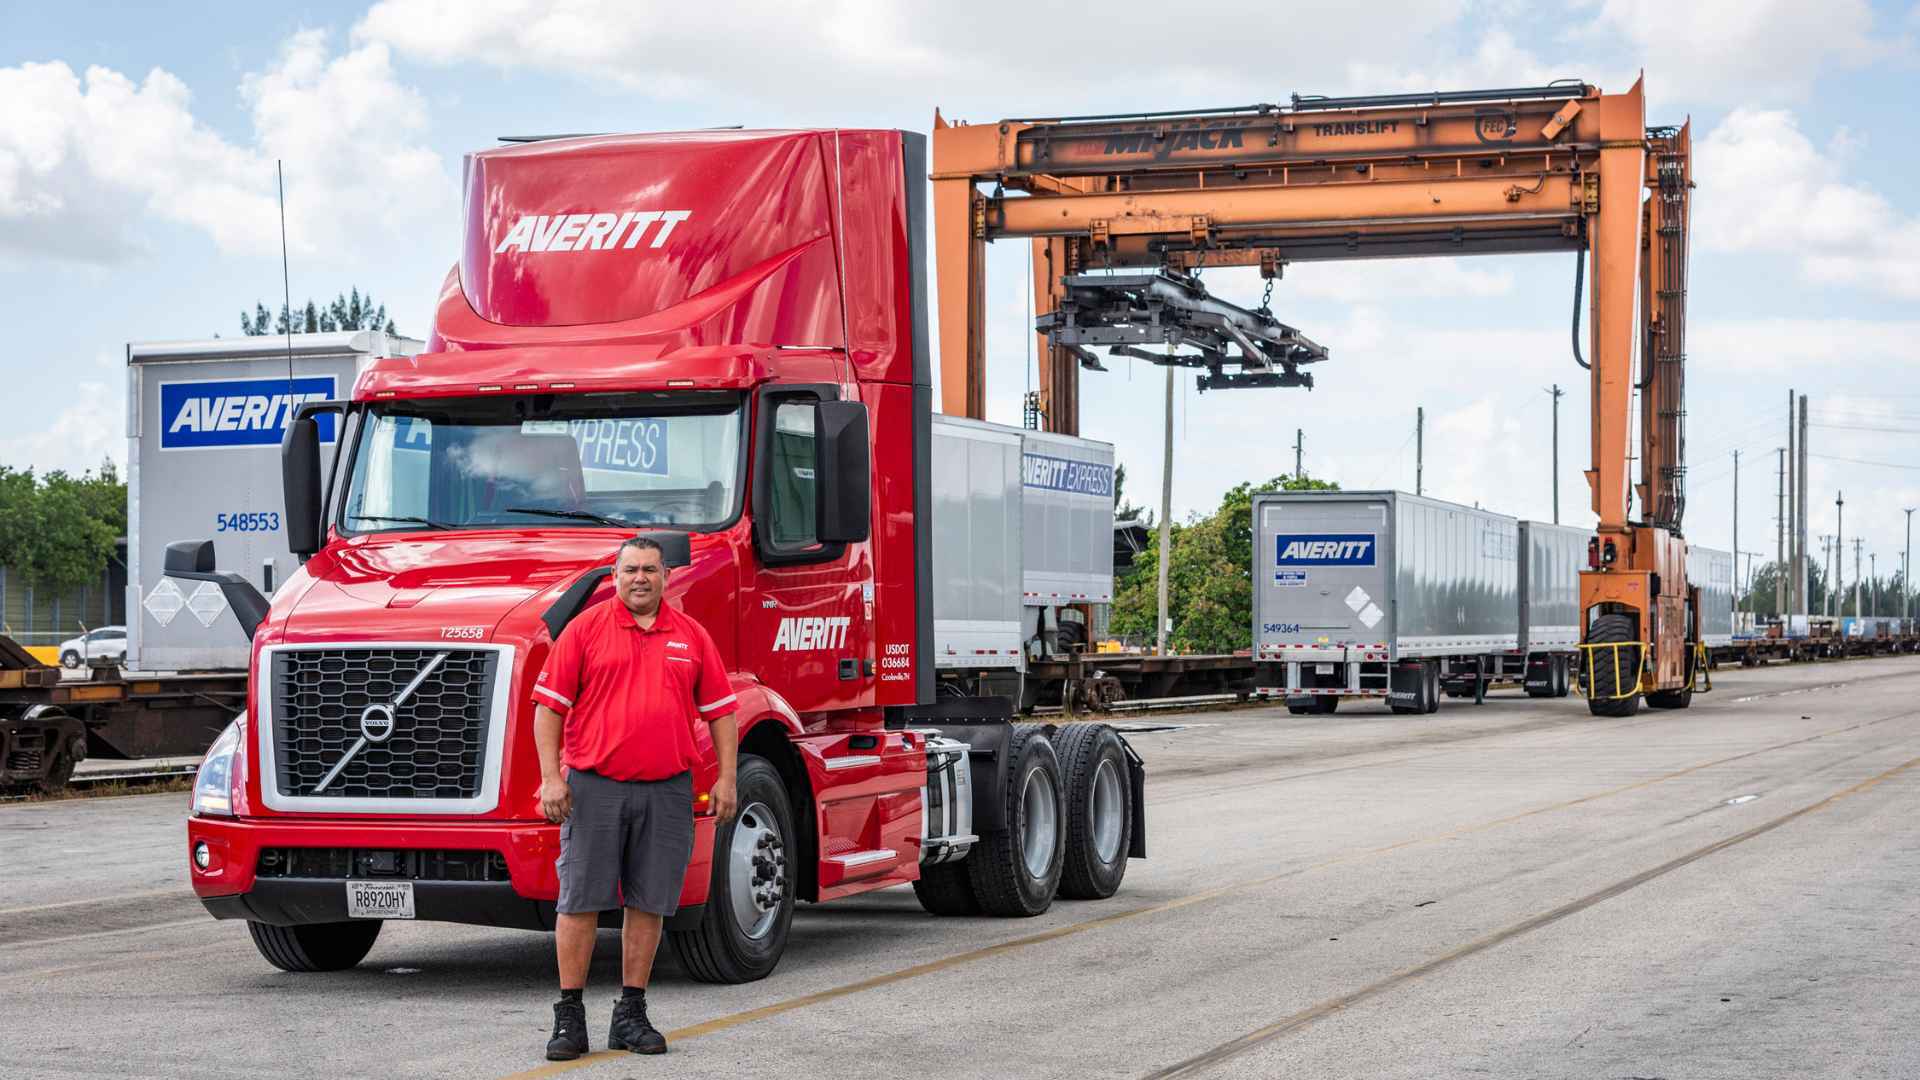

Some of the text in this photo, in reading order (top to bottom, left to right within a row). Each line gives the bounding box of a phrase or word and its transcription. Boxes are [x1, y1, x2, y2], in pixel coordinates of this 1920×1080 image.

[1312, 119, 1399, 137] TRANSLIFT
[495, 210, 693, 253] AVERITT
[1067, 463, 1110, 494] EXPRESS
[217, 512, 279, 532] 548553
[1280, 541, 1371, 559] AVERITT
[441, 627, 484, 639] T25658
[772, 616, 851, 652] AVERITT
[1263, 623, 1300, 634] 549364
[885, 644, 910, 655] USDOT
[881, 657, 910, 668] 036684
[355, 891, 406, 908] R8920HY
